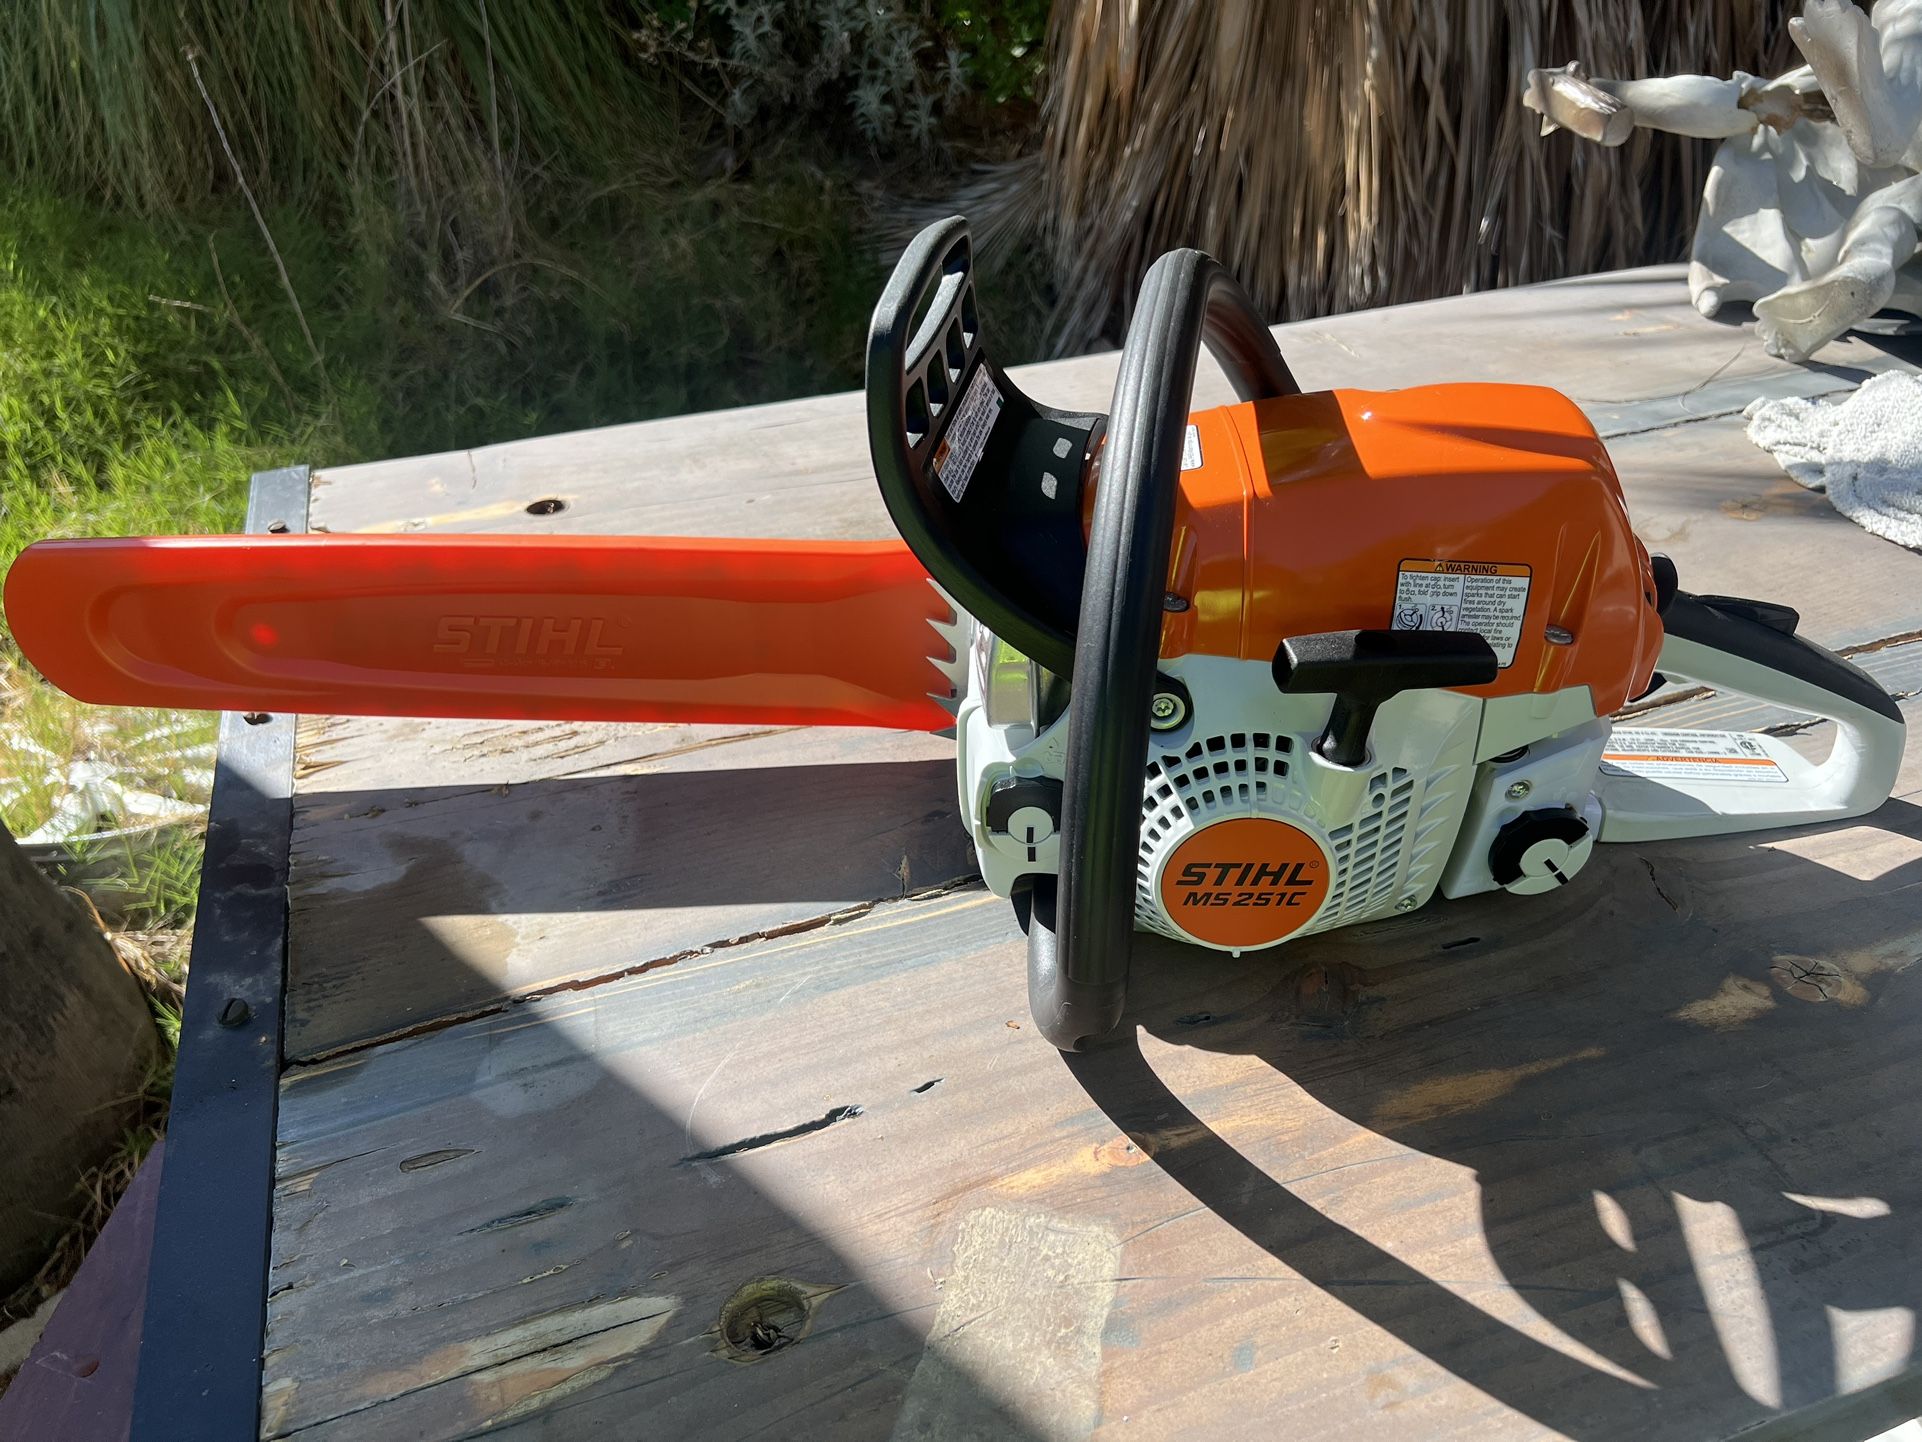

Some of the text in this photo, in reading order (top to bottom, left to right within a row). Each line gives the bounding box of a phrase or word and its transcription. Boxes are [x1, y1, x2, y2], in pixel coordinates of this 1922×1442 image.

[1446, 564, 1498, 574] WARNING
[1410, 574, 1429, 582] tighten
[1466, 576, 1494, 584] Operation
[433, 615, 625, 656] STIHL
[1176, 862, 1314, 887] STIHL
